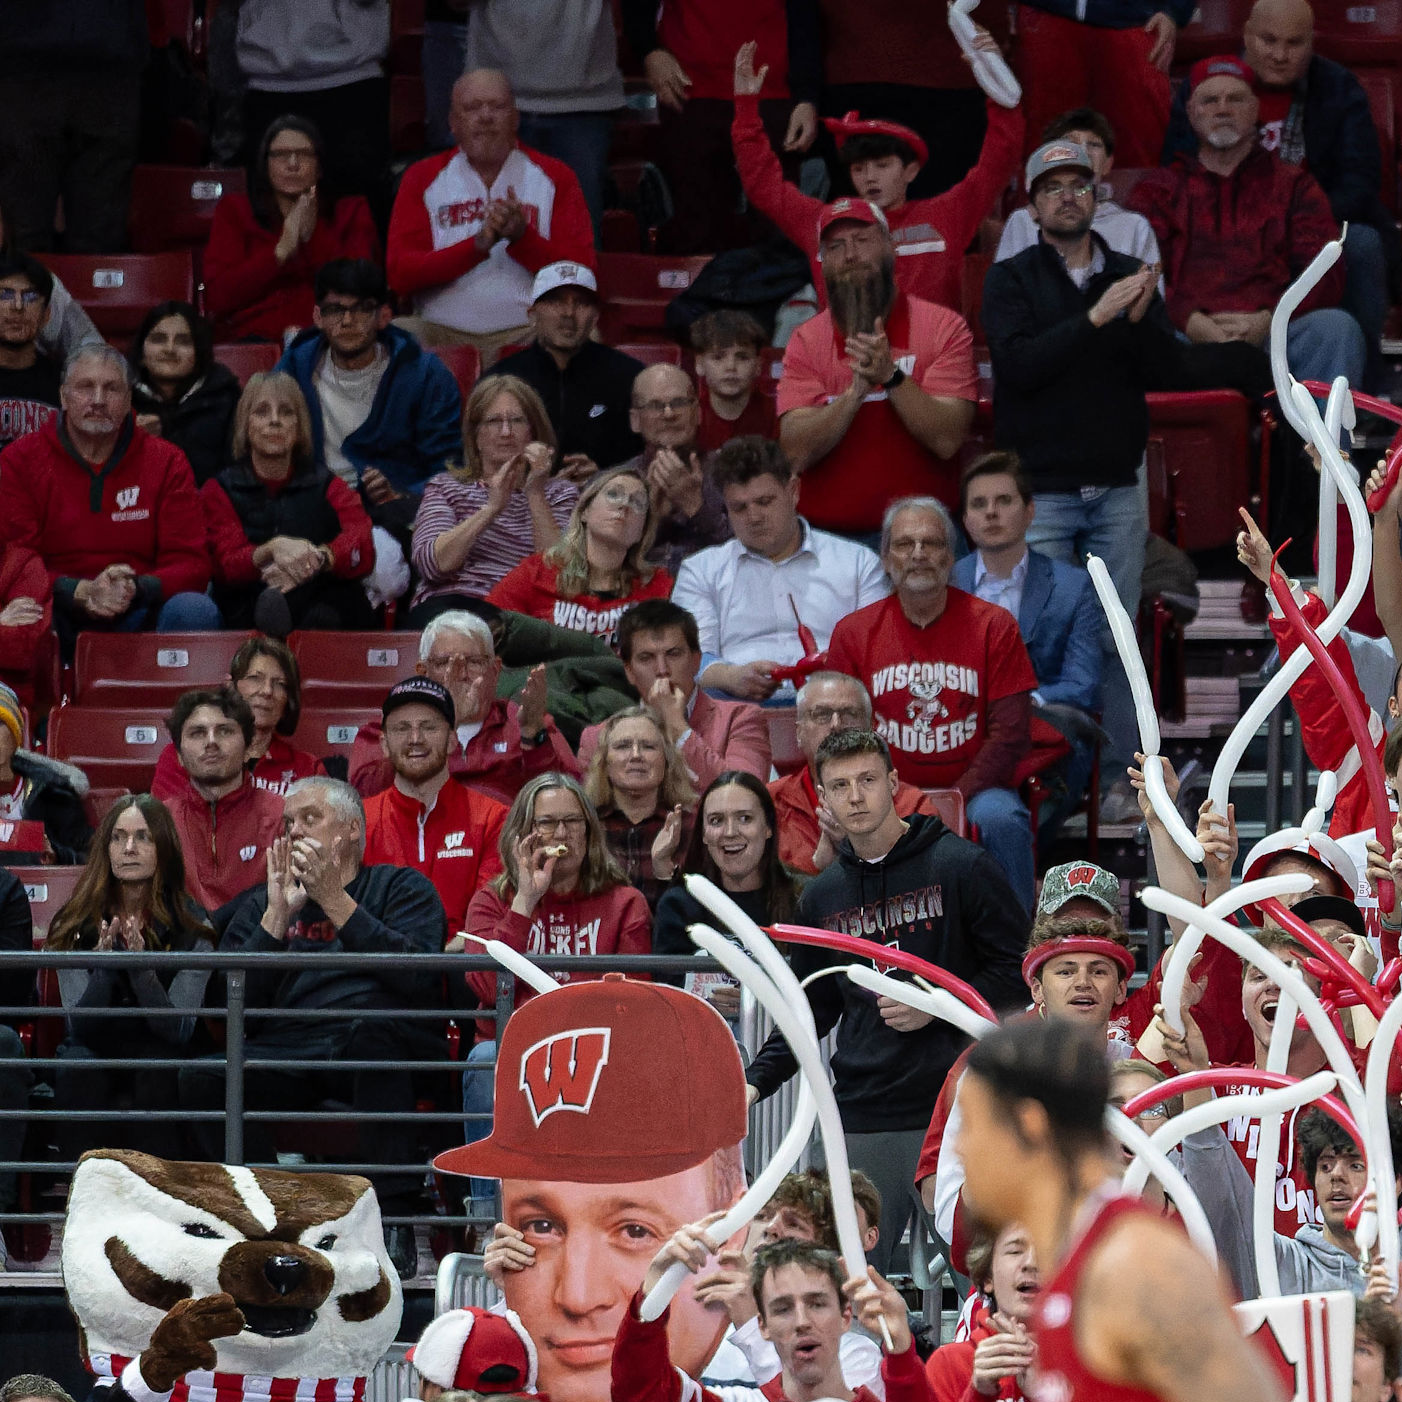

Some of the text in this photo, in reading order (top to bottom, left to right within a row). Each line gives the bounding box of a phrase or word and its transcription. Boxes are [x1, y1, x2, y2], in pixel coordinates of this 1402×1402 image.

[117, 486, 140, 510] W
[553, 599, 634, 636] WISCON
[872, 661, 978, 698] WISCONSIN
[444, 831, 465, 850] W
[241, 845, 257, 862] W
[437, 848, 473, 859] WISCONSIN
[1066, 867, 1096, 890] W
[519, 1026, 611, 1128] W
